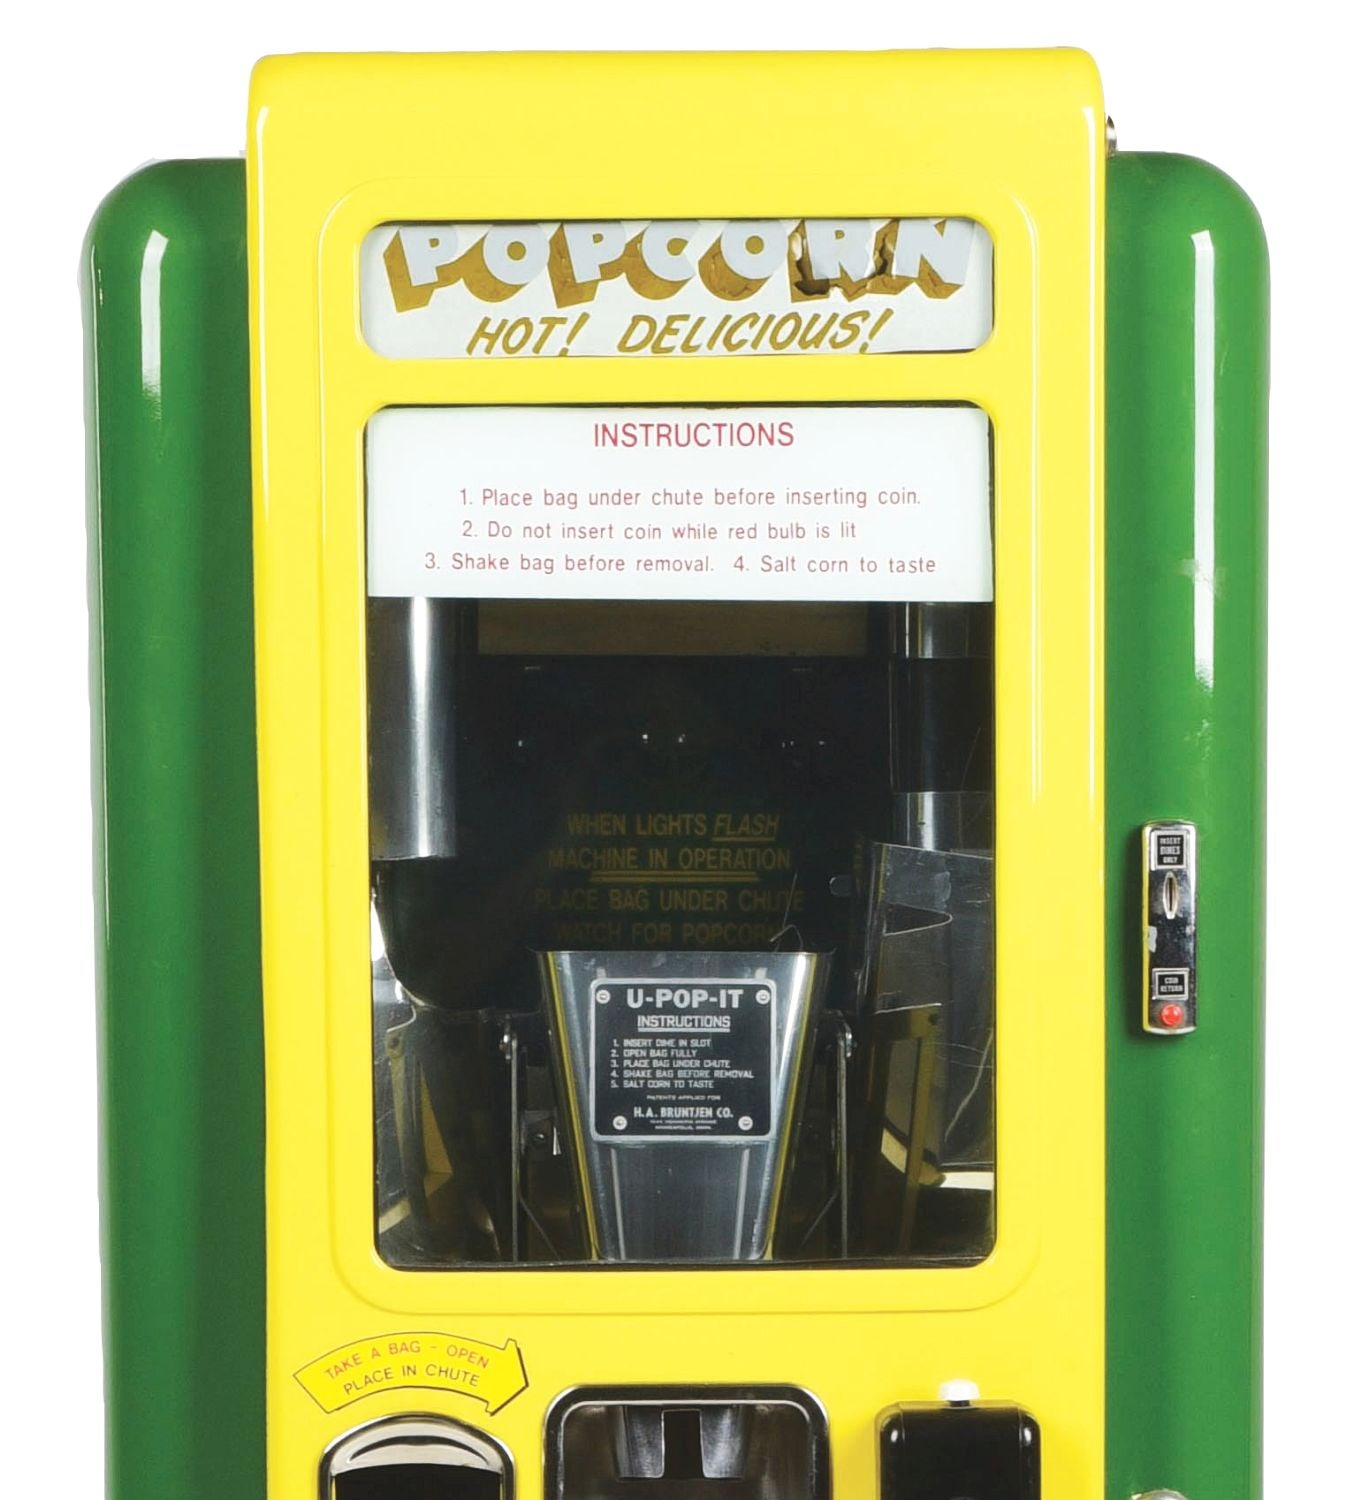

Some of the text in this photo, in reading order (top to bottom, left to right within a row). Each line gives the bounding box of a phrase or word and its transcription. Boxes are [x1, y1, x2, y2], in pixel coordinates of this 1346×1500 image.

[384, 219, 974, 310] POPCORN
[466, 307, 894, 357] HOT! DELICIOUS!
[595, 422, 794, 447] INSTRUCTIONS
[460, 487, 920, 510] 1. Place bag under chute before inserting coin.
[463, 520, 856, 539] 2. Do not insert coin while red bulb is lit
[425, 552, 935, 574] 3. Shake bag before removal. 4. Salt corn to taste
[567, 813, 780, 837] WHEN LIGHTS FLASH
[547, 847, 791, 870] MACHINE IN OPERATION
[534, 888, 806, 912] PLACE BAG UNDER CHUTE
[553, 921, 622, 944] WATCH
[632, 921, 672, 945] FOR
[626, 988, 744, 1009] U-POP-IT
[638, 1015, 730, 1028] INSTRUCTIONS
[610, 1049, 698, 1058] 2. OPEN BAG FULLY
[612, 1039, 619, 1048] 1.
[623, 1039, 653, 1048] INSERT
[678, 1039, 687, 1048] IN
[690, 1039, 712, 1048] SLOT
[610, 1070, 755, 1079] 4. SHAKE BAG BEFORE REMOVAL
[623, 1059, 650, 1068] PLACE
[652, 1059, 670, 1068] BAG
[673, 1059, 700, 1068] UNDER
[703, 1059, 731, 1068] CHUTE
[623, 1080, 645, 1089] SALT
[647, 1080, 671, 1089] CORN
[673, 1080, 685, 1089] TO
[688, 1080, 714, 1089] TASTE
[660, 1107, 713, 1119] BRUNTJEN
[716, 1107, 734, 1119] CO.
[323, 1353, 363, 1380] TAKE
[371, 1347, 381, 1360] A
[388, 1341, 421, 1355] BAG
[446, 1344, 490, 1369] OPEN
[343, 1364, 480, 1395] PLACE IN CHUTE
